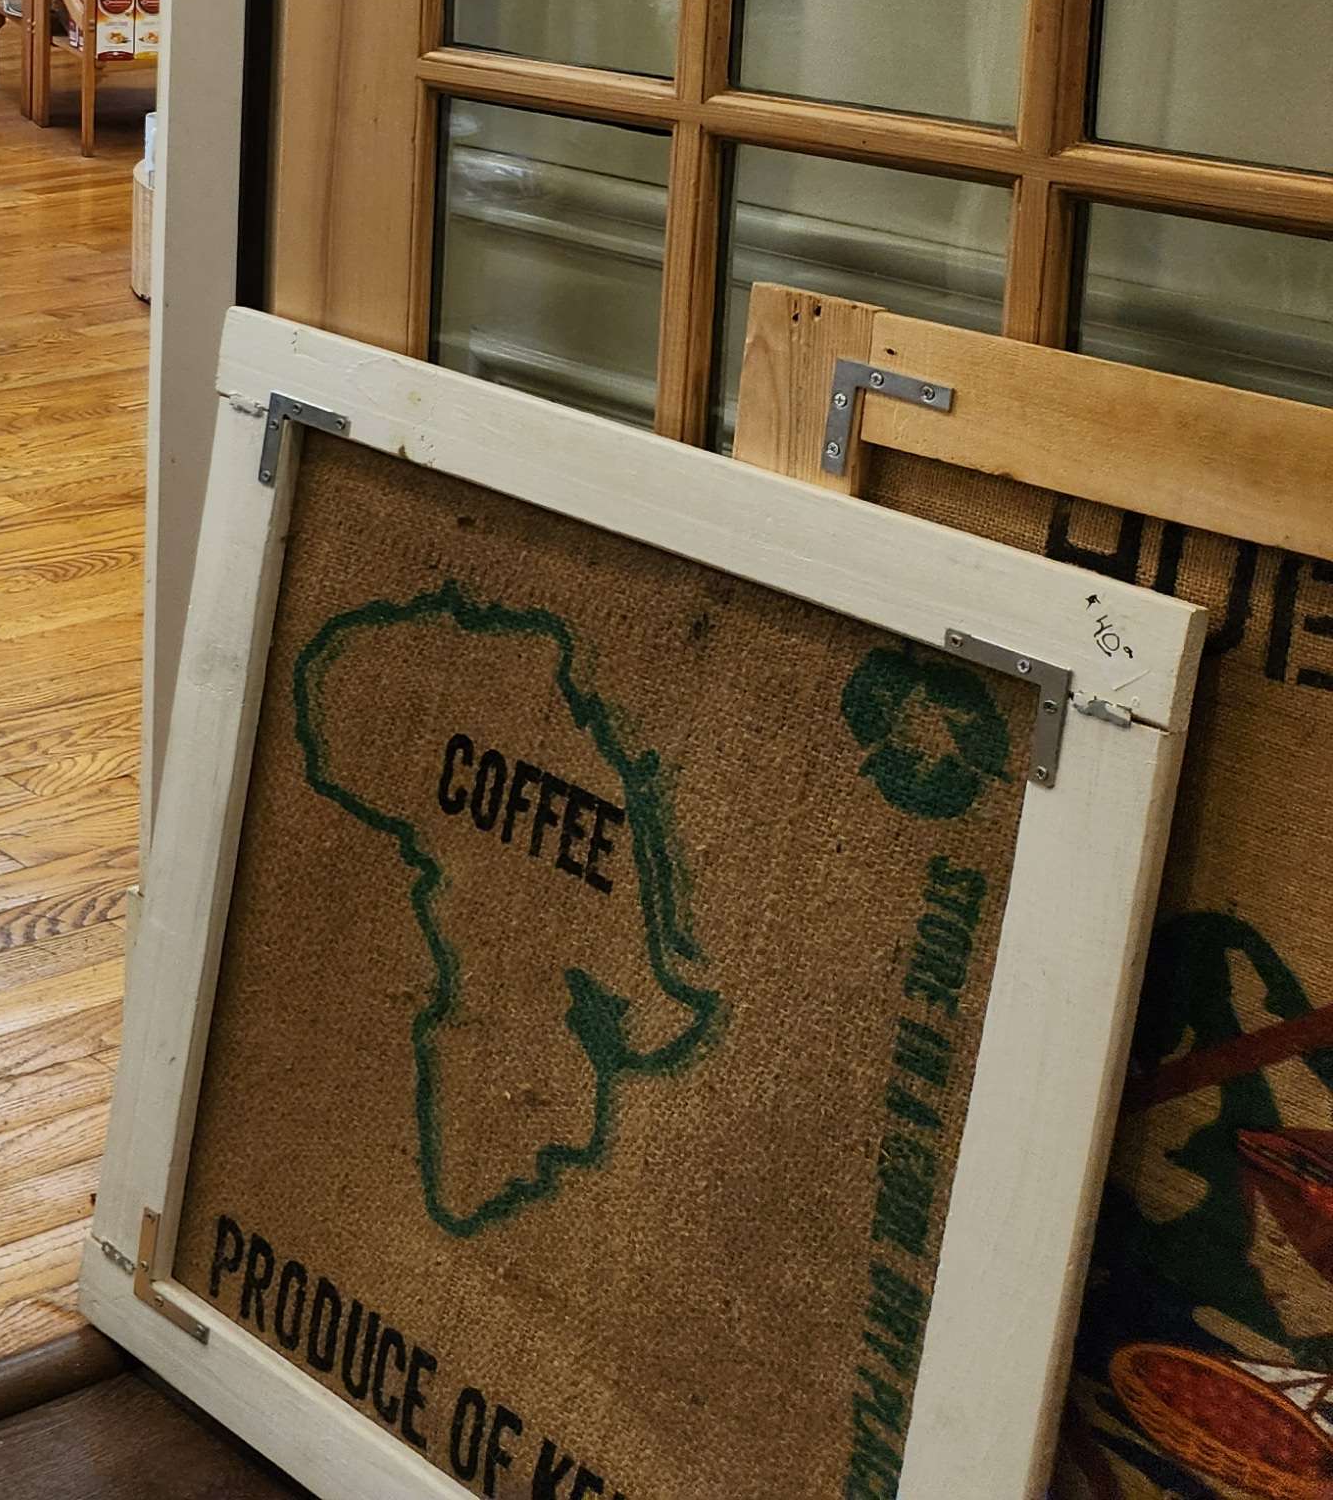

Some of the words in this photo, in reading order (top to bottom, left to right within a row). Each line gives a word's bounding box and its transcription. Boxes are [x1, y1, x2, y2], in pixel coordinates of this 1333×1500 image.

[438, 733, 625, 895] COFFEE
[903, 854, 988, 1020] STORE
[891, 1016, 952, 1089] IN
[871, 1130, 939, 1257] COOL
[208, 1214, 438, 1451] PRODUCE
[449, 1386, 524, 1500] OF
[861, 1259, 932, 1374] DRY
